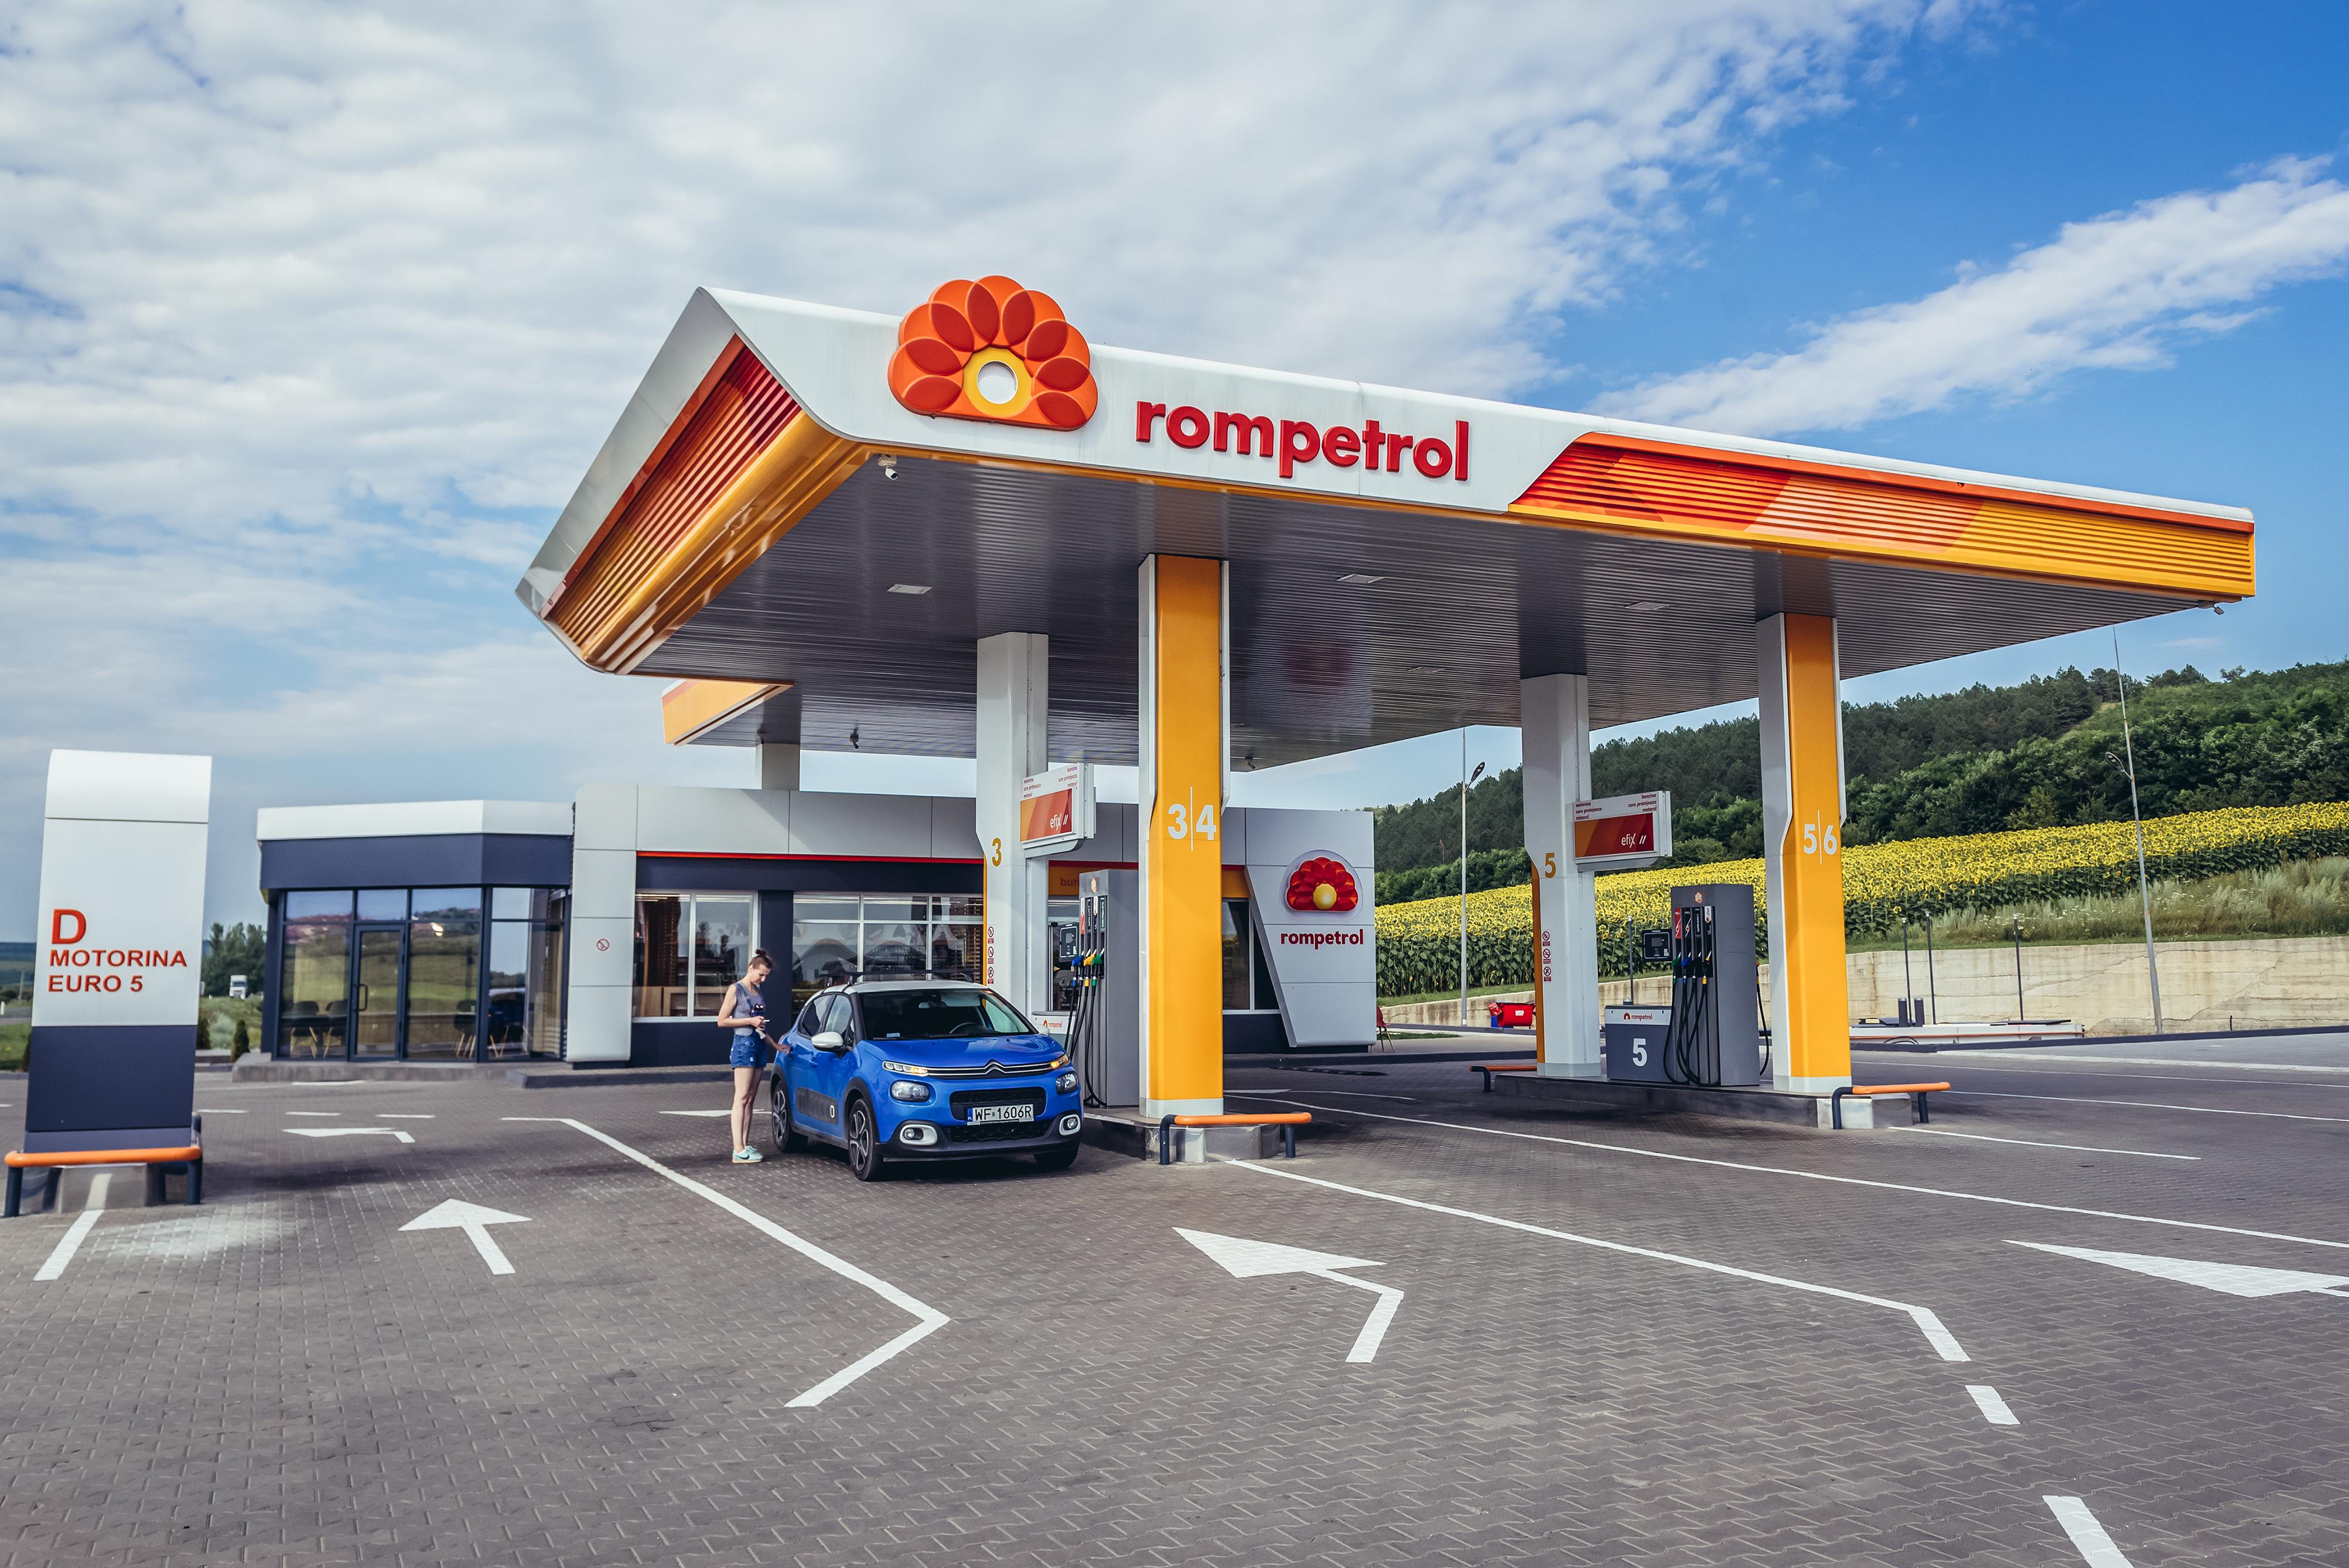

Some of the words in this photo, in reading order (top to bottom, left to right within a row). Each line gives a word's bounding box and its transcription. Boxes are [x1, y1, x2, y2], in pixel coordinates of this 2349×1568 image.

[1135, 401, 1470, 481] rompetrol
[1050, 813, 1062, 831] efix
[1621, 833, 1636, 848] efix
[992, 837, 1002, 867] 3
[1545, 852, 1556, 879] 5
[52, 908, 86, 944] D
[1281, 928, 1364, 950] rompetrol
[49, 949, 187, 967] MOTORINA
[48, 975, 121, 992] EURO
[130, 975, 143, 992] 5
[1633, 1038, 1647, 1067] 5
[975, 1108, 991, 1121] WF
[997, 1106, 1032, 1119] 1606R
